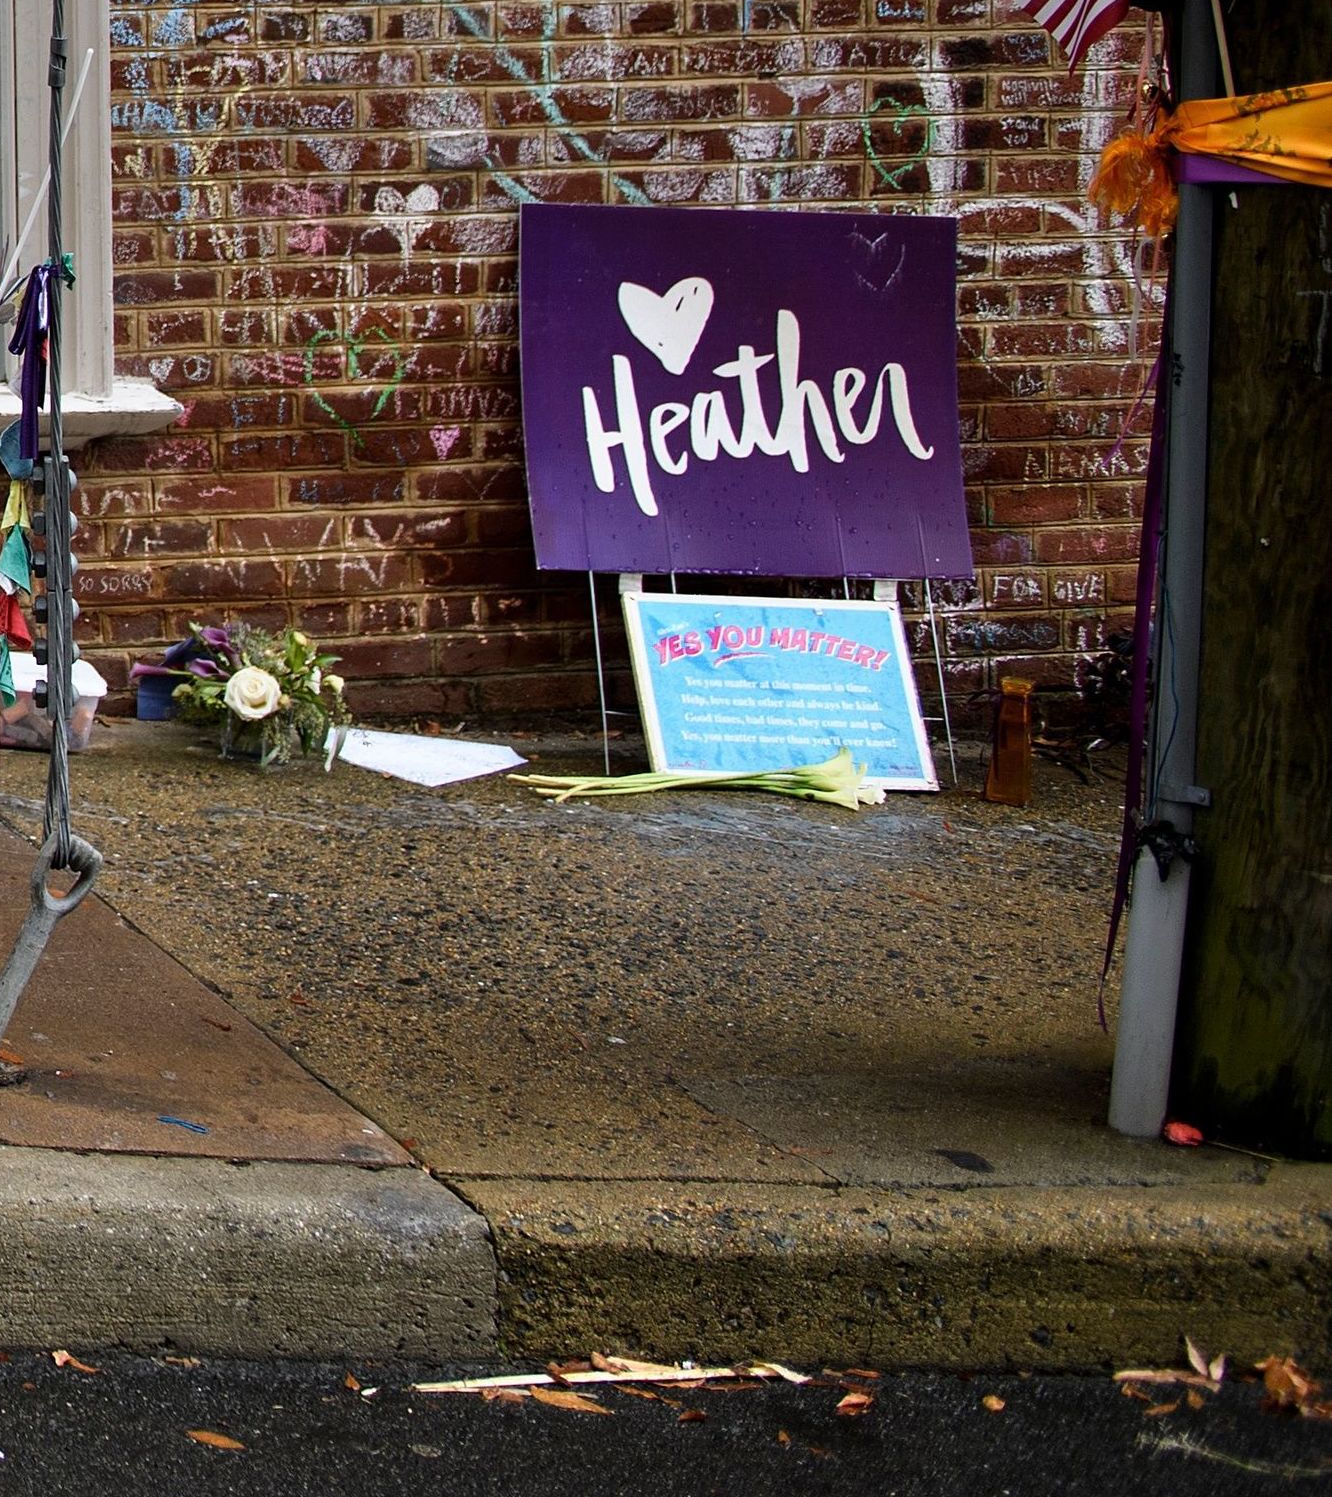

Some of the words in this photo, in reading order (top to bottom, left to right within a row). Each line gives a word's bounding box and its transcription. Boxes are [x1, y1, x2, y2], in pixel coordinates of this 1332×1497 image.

[583, 308, 934, 516] Heather
[653, 630, 703, 667] YES
[706, 625, 764, 653] YOU
[769, 626, 890, 672] MATTER!
